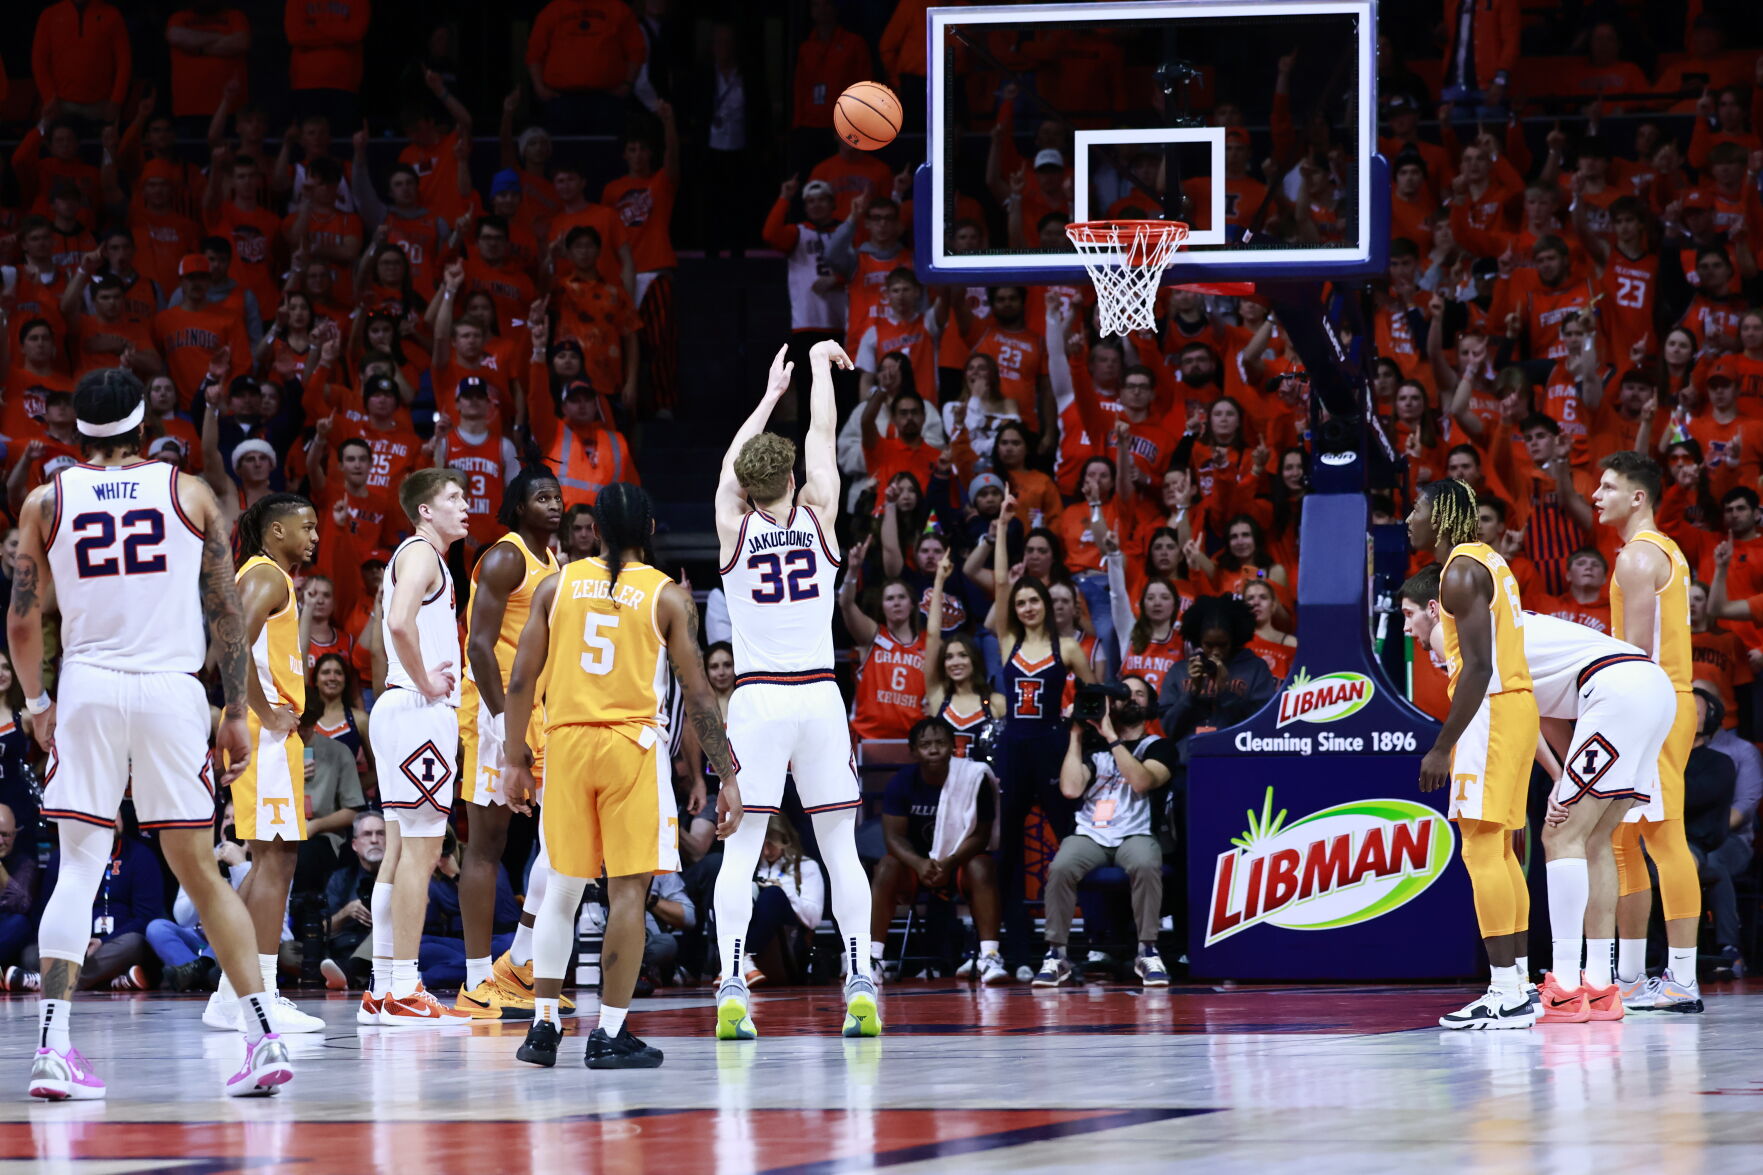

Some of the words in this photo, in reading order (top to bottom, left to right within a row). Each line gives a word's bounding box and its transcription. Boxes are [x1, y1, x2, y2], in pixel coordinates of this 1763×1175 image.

[1616, 277, 1646, 309] 23
[998, 346, 1022, 369] 23
[1562, 399, 1577, 422] 6
[92, 482, 140, 501] WHITE
[471, 475, 486, 497] 3
[73, 508, 167, 579] 22
[748, 530, 814, 554] JAKUCIONIS
[747, 548, 820, 604] 32
[571, 579, 645, 610] ZEIGLER
[580, 611, 620, 676] 5
[874, 649, 925, 672] ORANG
[891, 666, 908, 691] 6
[1279, 680, 1365, 724] LIBMAN
[1234, 731, 1313, 756] Cleaning
[1317, 731, 1364, 752] Since
[1370, 731, 1417, 752] 1896
[1454, 773, 1477, 801] T
[262, 797, 290, 825] T
[1210, 819, 1432, 938] LIBMAN
